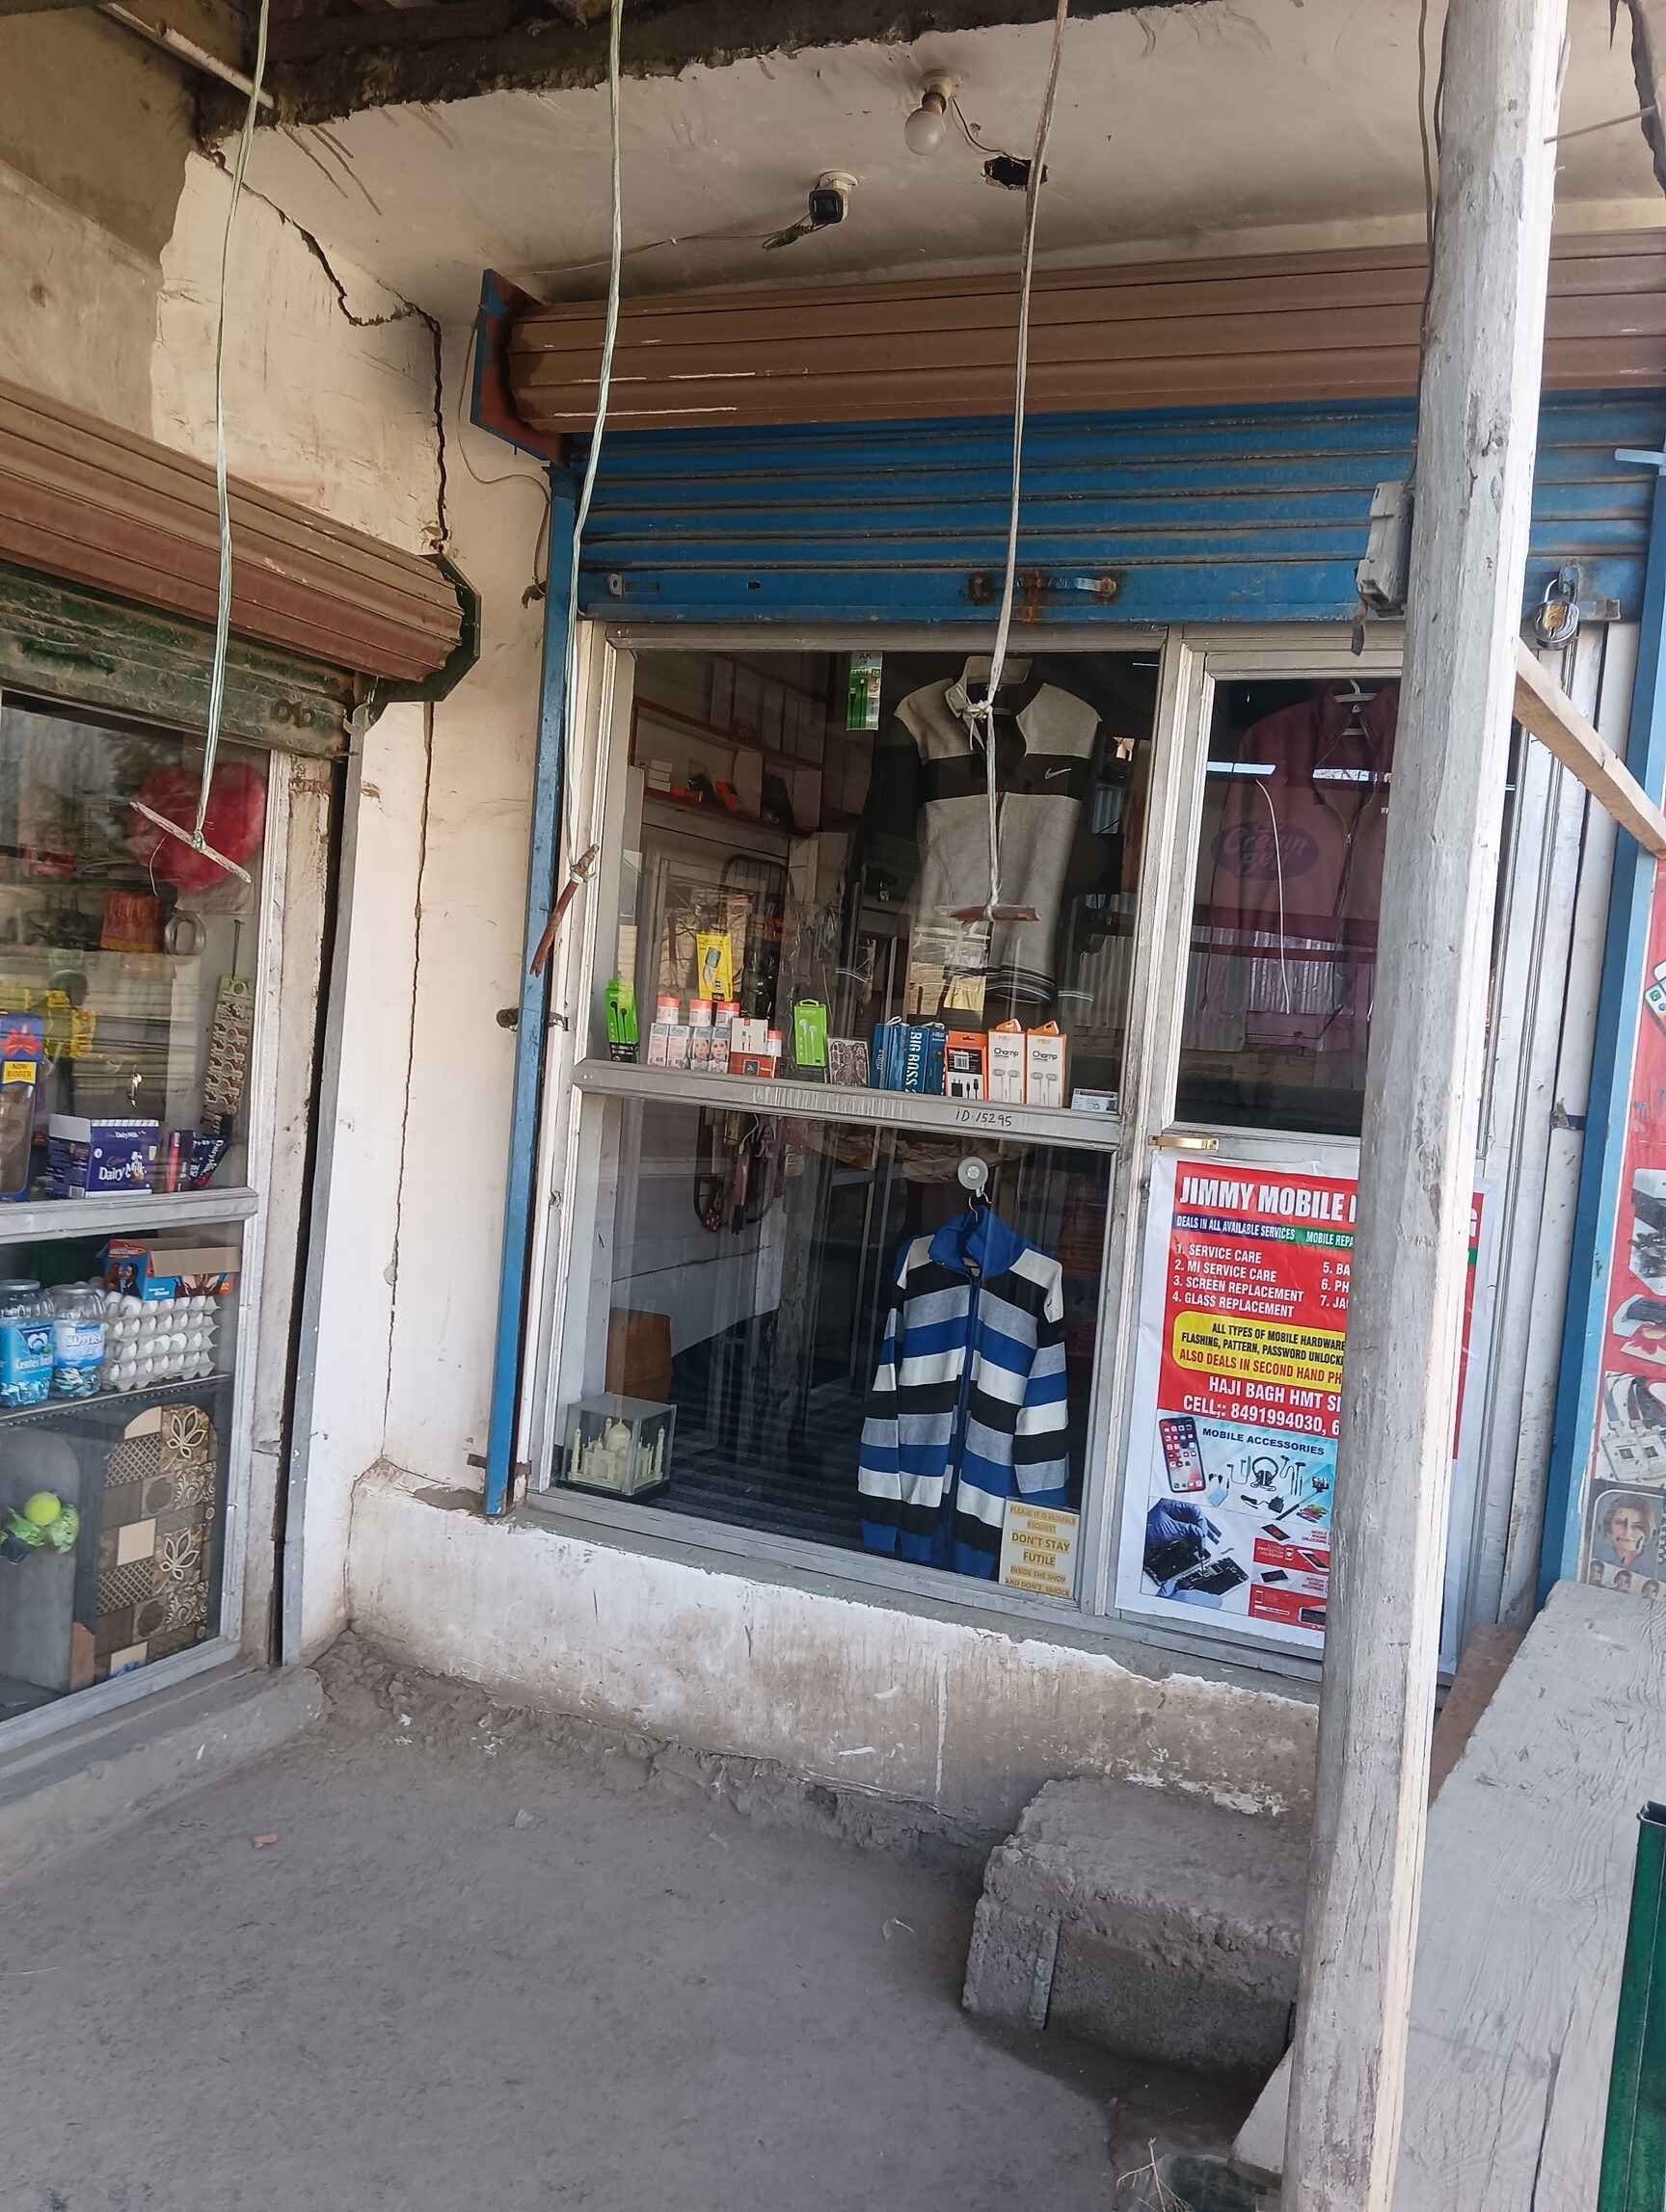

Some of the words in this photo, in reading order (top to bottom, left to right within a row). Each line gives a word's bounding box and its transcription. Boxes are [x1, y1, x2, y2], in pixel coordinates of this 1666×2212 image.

[858, 652, 872, 660] AK
[1223, 827, 1308, 855] Cream
[909, 1030, 923, 1053] BIG
[994, 1047, 1019, 1058] Champ
[1033, 1050, 1058, 1061] Champ
[98, 1165, 126, 1182] Dairy
[125, 1160, 148, 1179] Milk
[1179, 1176, 1254, 1211] JIMMY
[1257, 1184, 1345, 1222] MOBILE
[1176, 1215, 1198, 1229] DEALS
[1199, 1218, 1207, 1230] IN
[1209, 1219, 1222, 1232] ALL
[1223, 1221, 1259, 1237] AVAILABLE
[1260, 1225, 1296, 1241] SERVICES
[1306, 1231, 1333, 1246] MOBILE
[1176, 1242, 1186, 1255] 1.
[1189, 1244, 1231, 1261] SERVICE
[1234, 1249, 1262, 1265] CARE
[1174, 1259, 1185, 1271] 2.
[1187, 1261, 1200, 1273] MI
[1203, 1262, 1247, 1280] SERVICE
[1249, 1267, 1277, 1283] CARE
[1322, 1262, 1333, 1274] 5.
[1172, 1275, 1183, 1287] 3.
[1186, 1276, 1225, 1293] SCREEN
[1228, 1281, 1304, 1303] REPLACEMENT
[1320, 1278, 1331, 1292] 6.
[1171, 1291, 1182, 1303] 4.
[1185, 1292, 1217, 1308] GLASS
[1219, 1296, 1295, 1319] REPLACEMENT
[1320, 1294, 1330, 1308] 7.
[1332, 1295, 1349, 1310] JA
[1212, 1322, 1226, 1335] ALL
[1228, 1325, 1253, 1339] TYPES
[1254, 1328, 1266, 1340] OF
[1268, 1331, 1299, 1346] MOBILE
[1181, 1332, 1221, 1349] FLASHING,
[1223, 1339, 1260, 1355] PATTERN,
[1262, 1344, 1306, 1360] PASSWORD
[1179, 1348, 1203, 1363] ALSO
[1207, 1352, 1237, 1370] DEALS
[1240, 1358, 1250, 1372] IN
[1253, 1360, 1294, 1377] SECOND
[1297, 1366, 1325, 1381] HAND
[1209, 1376, 1241, 1397] HAJI
[1246, 1382, 1285, 1403] BAGH
[1290, 1389, 1324, 1409] HMT
[1230, 1403, 1327, 1436] 8491994030,
[1202, 1428, 1244, 1443] MOBILE
[1246, 1435, 1325, 1455] ACCESSORIES
[1009, 1505, 1033, 1518] PLEASE
[1048, 1512, 1076, 1526] HUMBLE
[1027, 1521, 1057, 1533] REQUEST
[1011, 1532, 1043, 1547] DON'T
[1045, 1538, 1070, 1552] STAY
[1023, 1552, 1056, 1566] FUTILE
[1005, 1578, 1020, 1586] AND
[1021, 1581, 1043, 1591] DON'T
[1010, 1565, 1032, 1577] INSIDE
[1034, 1570, 1046, 1580] THE
[1047, 1573, 1066, 1584] SHOP
